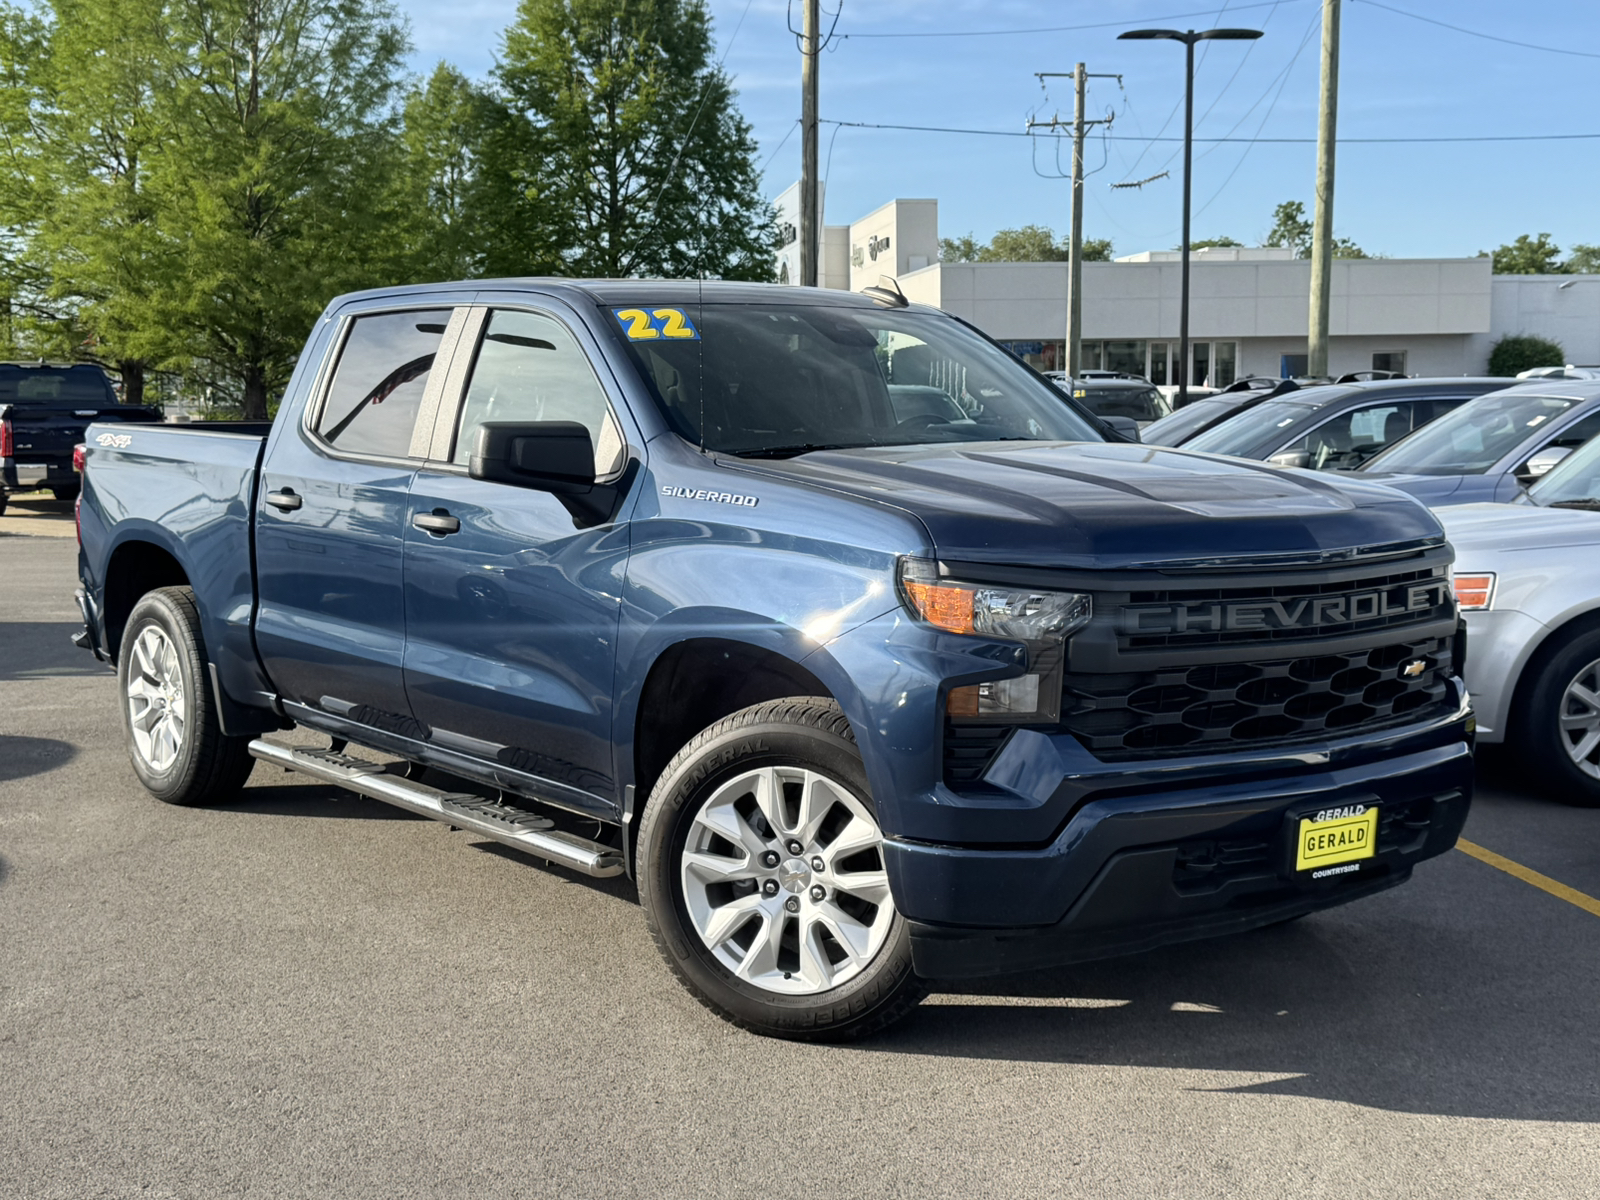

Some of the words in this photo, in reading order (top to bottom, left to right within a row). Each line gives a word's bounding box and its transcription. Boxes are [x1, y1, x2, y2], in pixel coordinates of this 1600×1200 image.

[617, 308, 694, 338] 22
[661, 486, 759, 507] SILVERADO
[1125, 582, 1448, 633] CHEVROLET
[671, 739, 769, 811] GENERAL
[1316, 804, 1364, 822] GERALD
[1307, 828, 1364, 852] GERALD
[1312, 863, 1360, 879] COUNTRYSIDE
